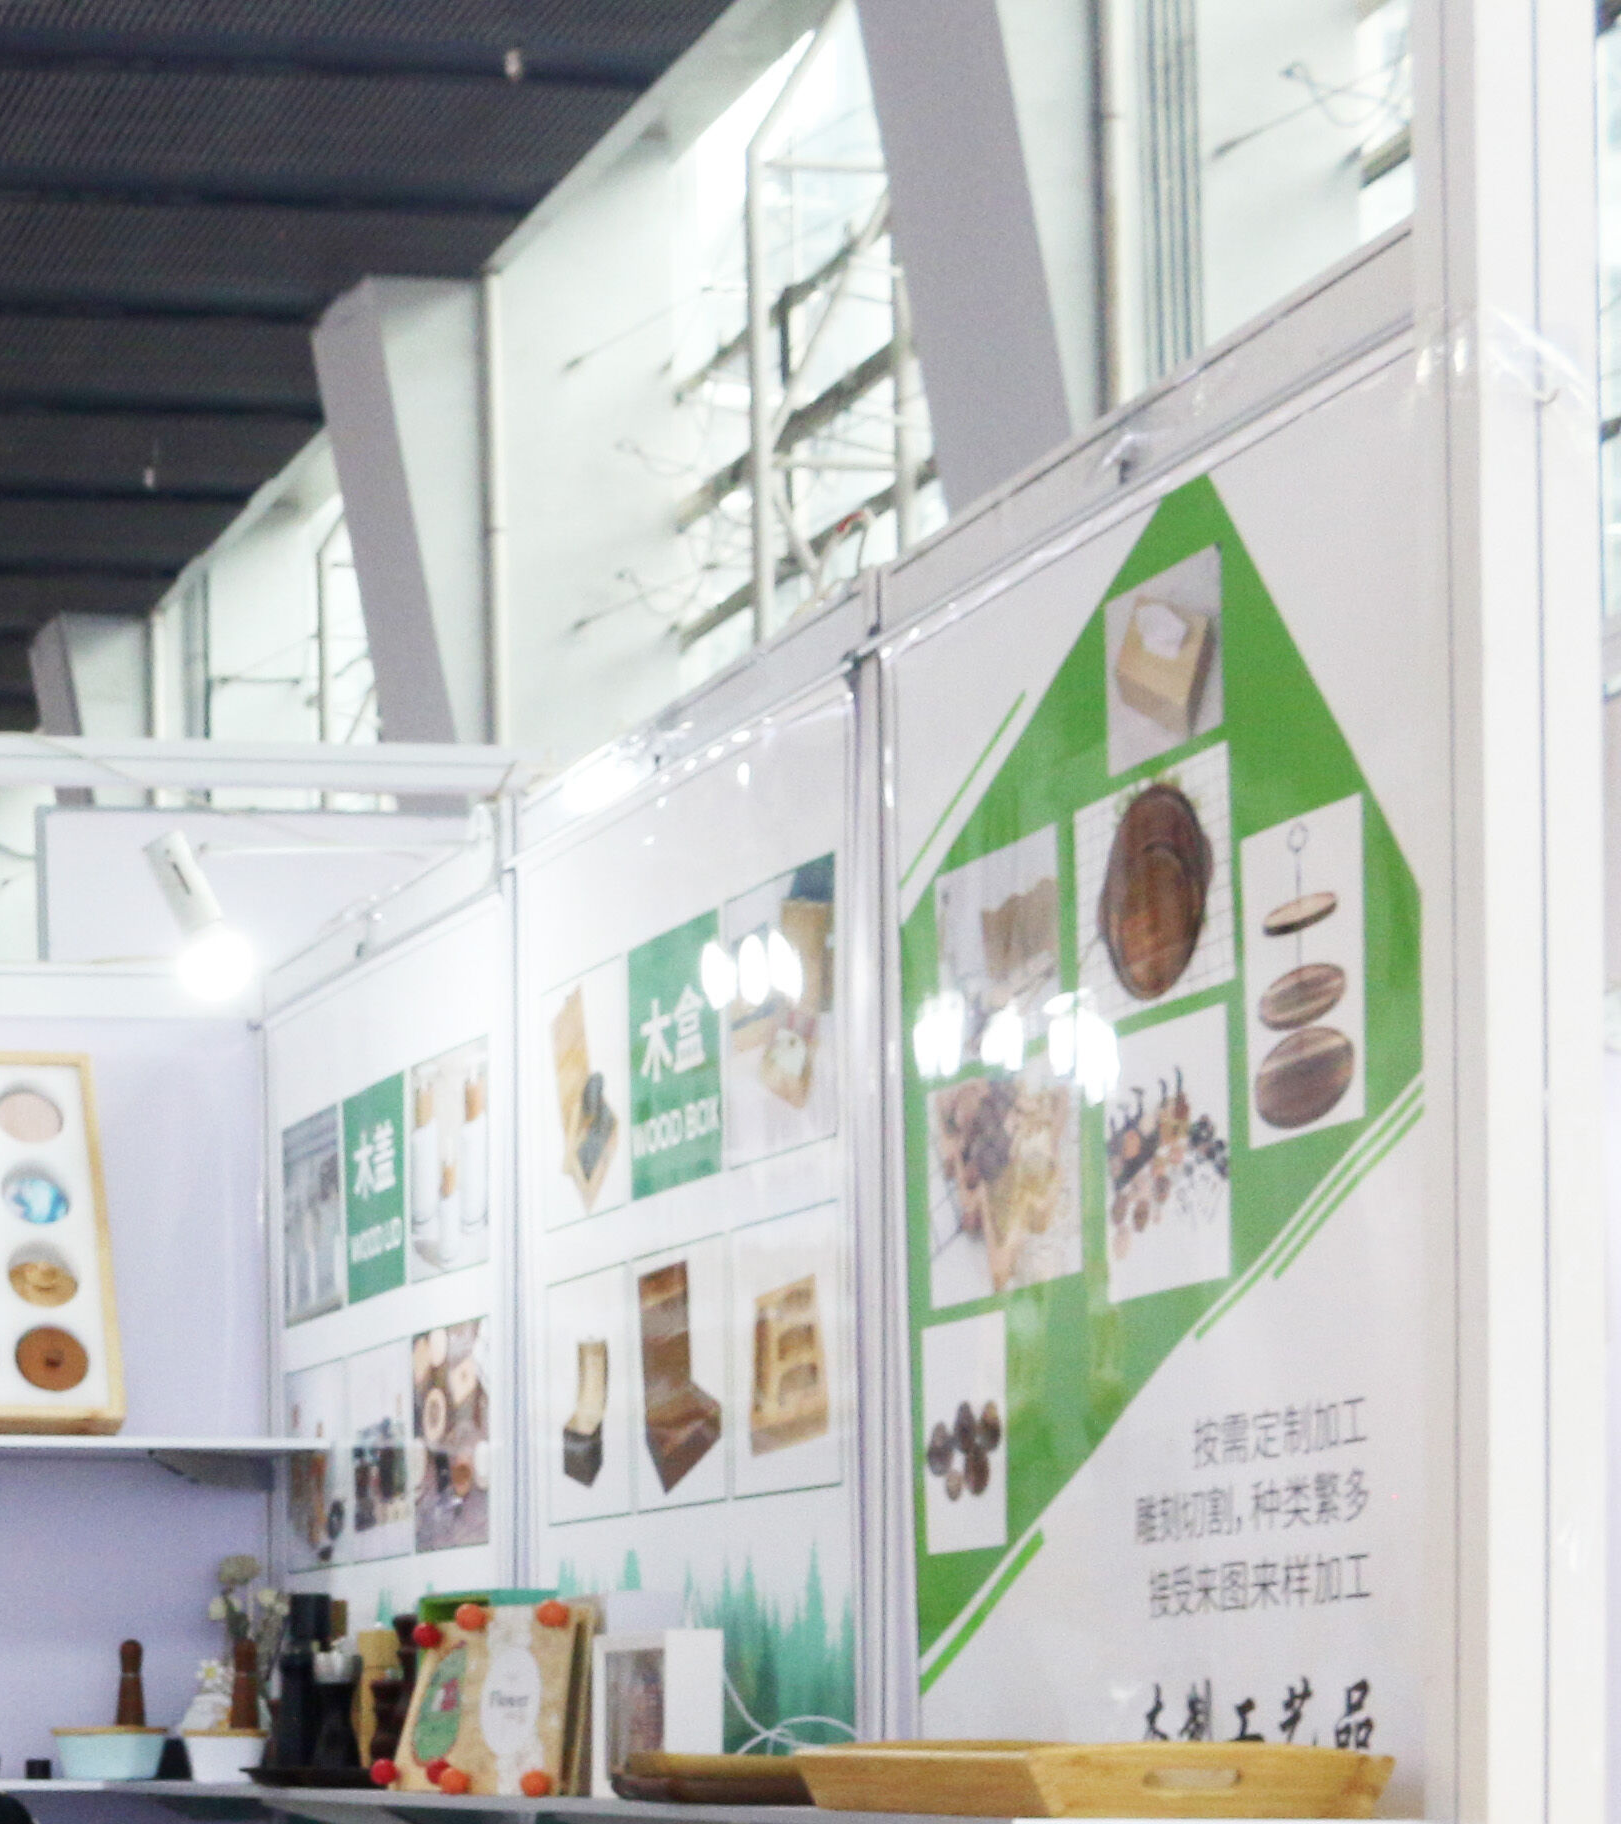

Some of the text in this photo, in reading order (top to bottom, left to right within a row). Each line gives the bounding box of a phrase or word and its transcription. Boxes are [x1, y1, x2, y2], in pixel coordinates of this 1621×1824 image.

[639, 983, 706, 1084] 木盒
[353, 1118, 397, 1201] 木盖
[631, 1096, 720, 1160] WOOD BOX
[1191, 1396, 1368, 1470] 按需定制加工
[1149, 1552, 1371, 1620] 接受来图来样加工
